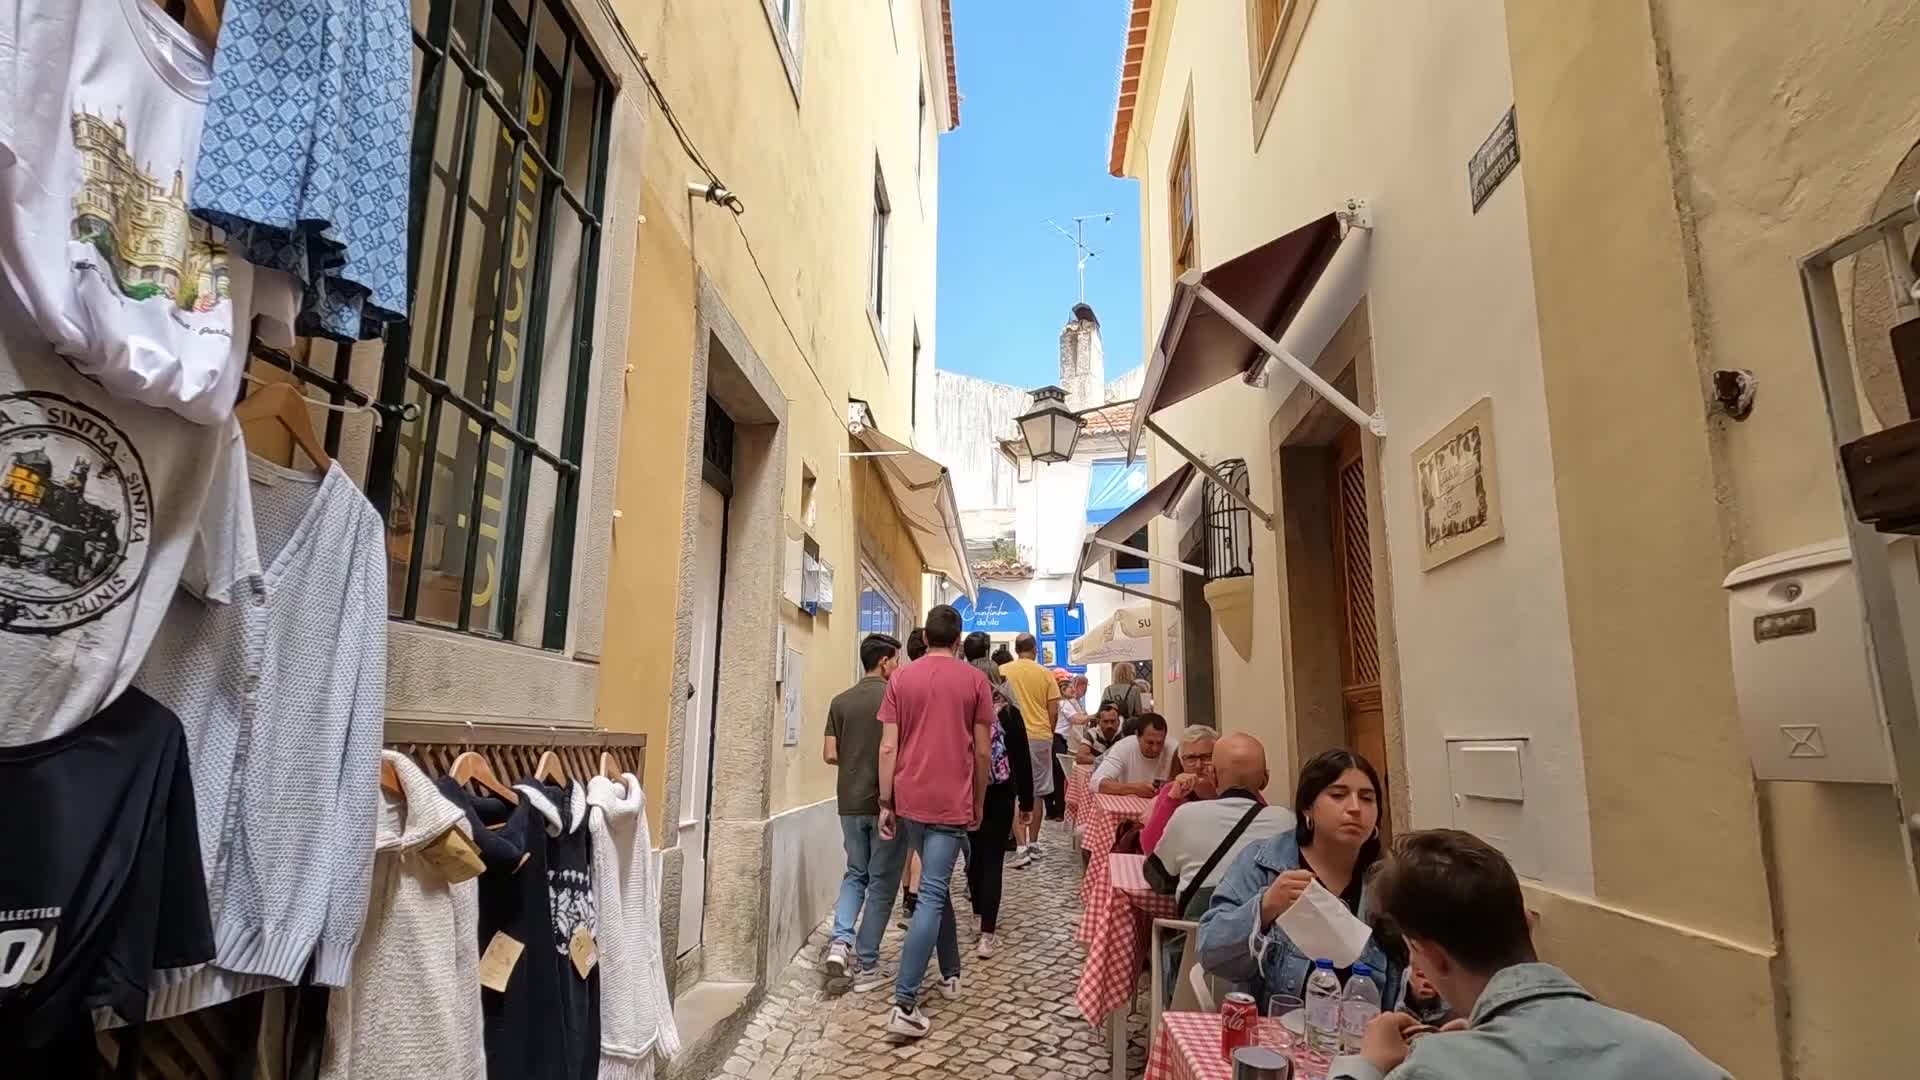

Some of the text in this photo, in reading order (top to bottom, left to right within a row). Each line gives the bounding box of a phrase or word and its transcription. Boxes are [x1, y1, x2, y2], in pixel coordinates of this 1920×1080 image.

[47, 406, 149, 620] SINTRA SINTRA SINTRA
